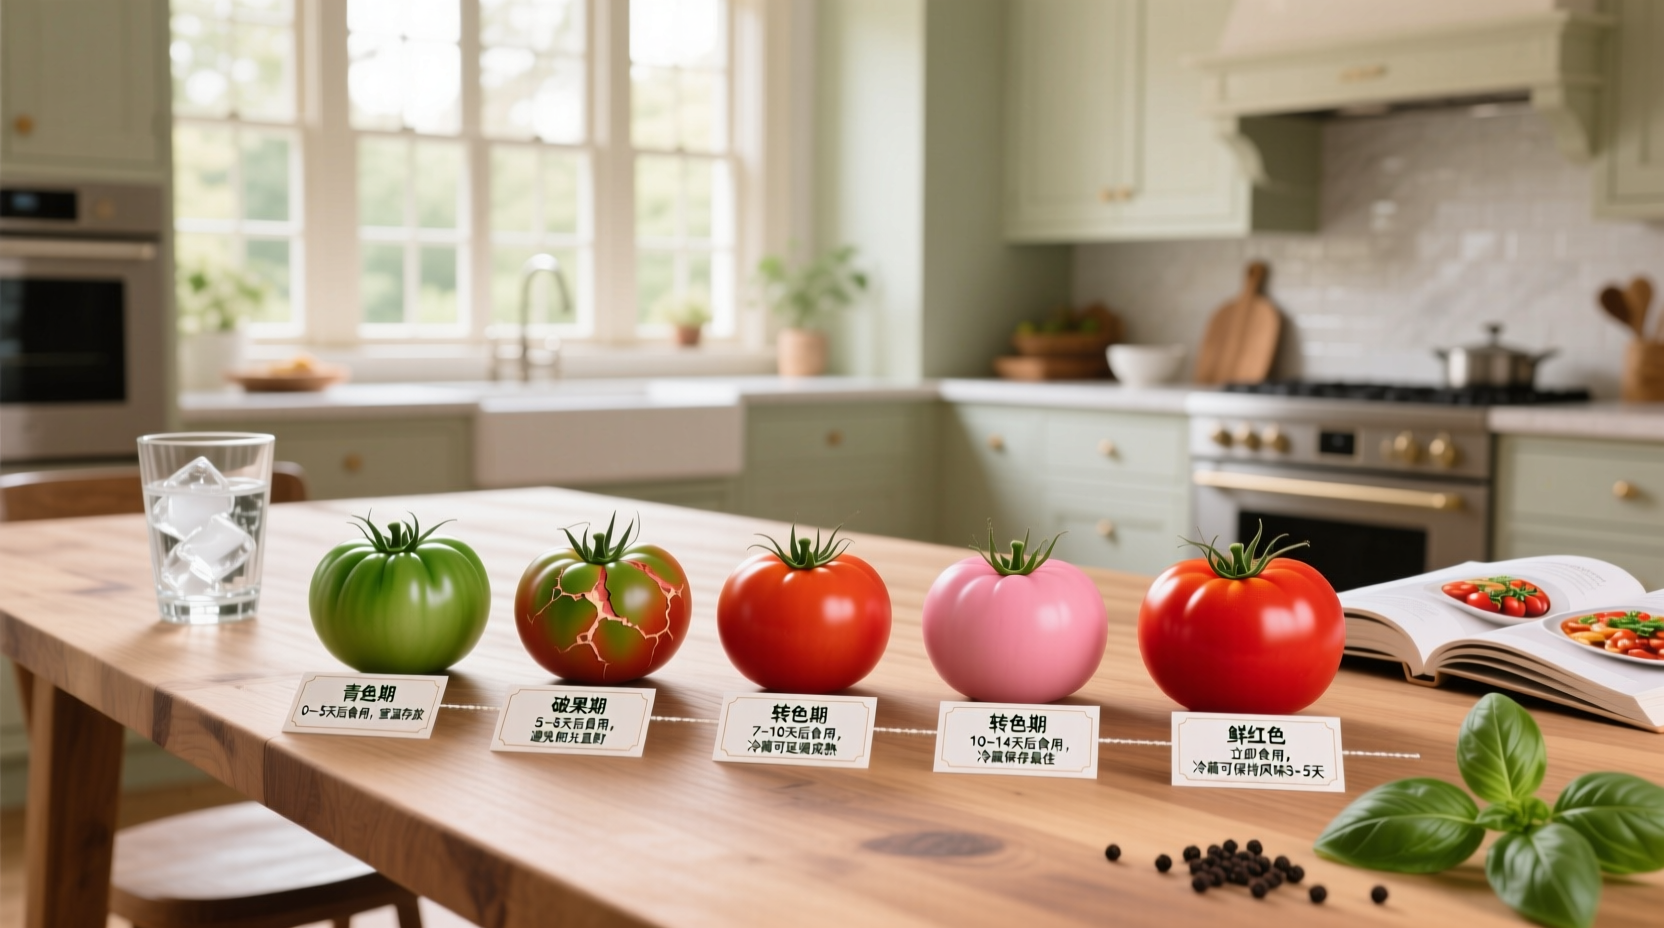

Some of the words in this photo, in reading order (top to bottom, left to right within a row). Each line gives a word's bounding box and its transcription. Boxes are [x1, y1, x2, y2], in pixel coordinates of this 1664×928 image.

[343, 682, 397, 703] 青色期
[551, 695, 608, 715] 破果期
[770, 703, 828, 724] 转色期
[988, 712, 1047, 734] 转色期
[1226, 724, 1286, 745] 鲜红色
